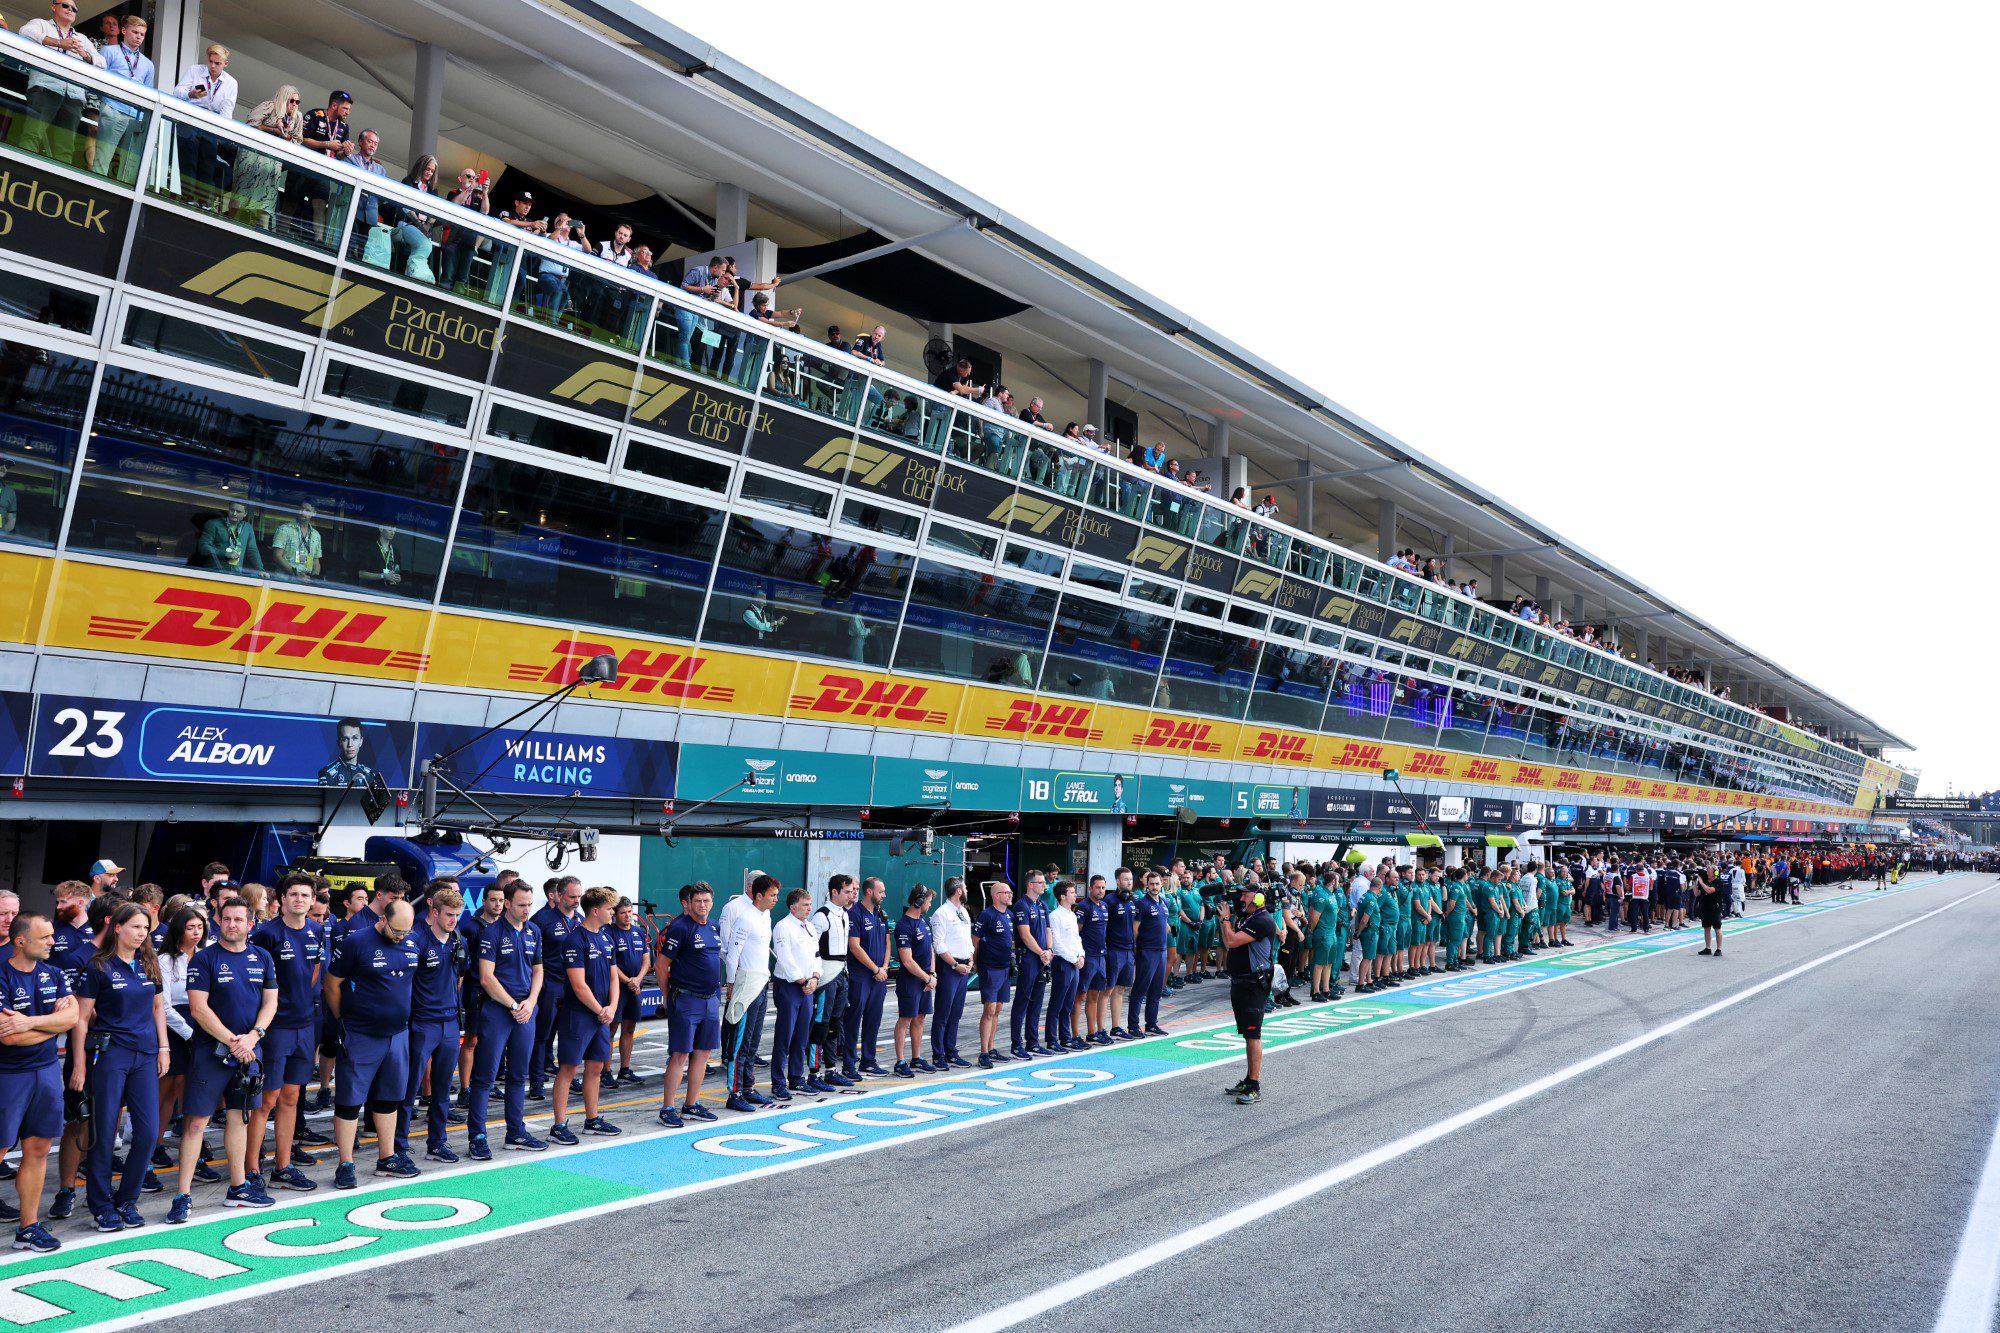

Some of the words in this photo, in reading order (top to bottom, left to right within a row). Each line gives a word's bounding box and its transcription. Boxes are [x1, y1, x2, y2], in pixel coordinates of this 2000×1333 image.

[0, 171, 110, 234] dock
[179, 251, 387, 330] F1
[389, 295, 510, 354] Paddock
[384, 323, 445, 361] Club
[549, 361, 691, 422] F1
[692, 390, 775, 435] Paddock
[687, 413, 731, 443] Club
[802, 437, 906, 486] F1
[906, 458, 967, 493] Paddock
[902, 477, 935, 502] Club
[986, 493, 1065, 533] F1
[1065, 509, 1111, 538] Paddock
[1061, 525, 1086, 546] Club
[1126, 536, 1188, 571] F1
[140, 587, 392, 666] DHL
[541, 639, 709, 699] DHL
[811, 674, 929, 722] DHL
[1002, 700, 1092, 739] DHL
[48, 707, 126, 758] 23
[177, 725, 228, 741] ALEX
[1146, 718, 1212, 752] DHL
[167, 744, 275, 766] ALBON
[505, 739, 606, 764] WILLIAMS
[1253, 732, 1307, 761] DHL
[1340, 743, 1384, 769] DHL
[514, 763, 593, 785] RACING
[1409, 752, 1447, 775] DHL
[1467, 759, 1500, 781] DHL
[1516, 766, 1543, 785] DHL
[12, 777, 24, 791] 46
[786, 773, 817, 783] aramco
[922, 785, 947, 793] cognizant
[955, 781, 979, 791] aramco
[1028, 780, 1050, 801] 18
[1066, 781, 1086, 790] LANCE
[663, 800, 674, 810] 44
[1063, 789, 1099, 803] STROLL
[1237, 791, 1248, 809] 5
[1258, 799, 1281, 810] VETTEL
[1429, 800, 1438, 818] 22
[584, 831, 595, 841] W
[775, 829, 824, 838] WILLIAMS
[826, 830, 865, 839] RACING
[1369, 836, 1398, 844] cognizant
[692, 1067, 1116, 1157] aramco
[0, 1196, 492, 1326] mco
